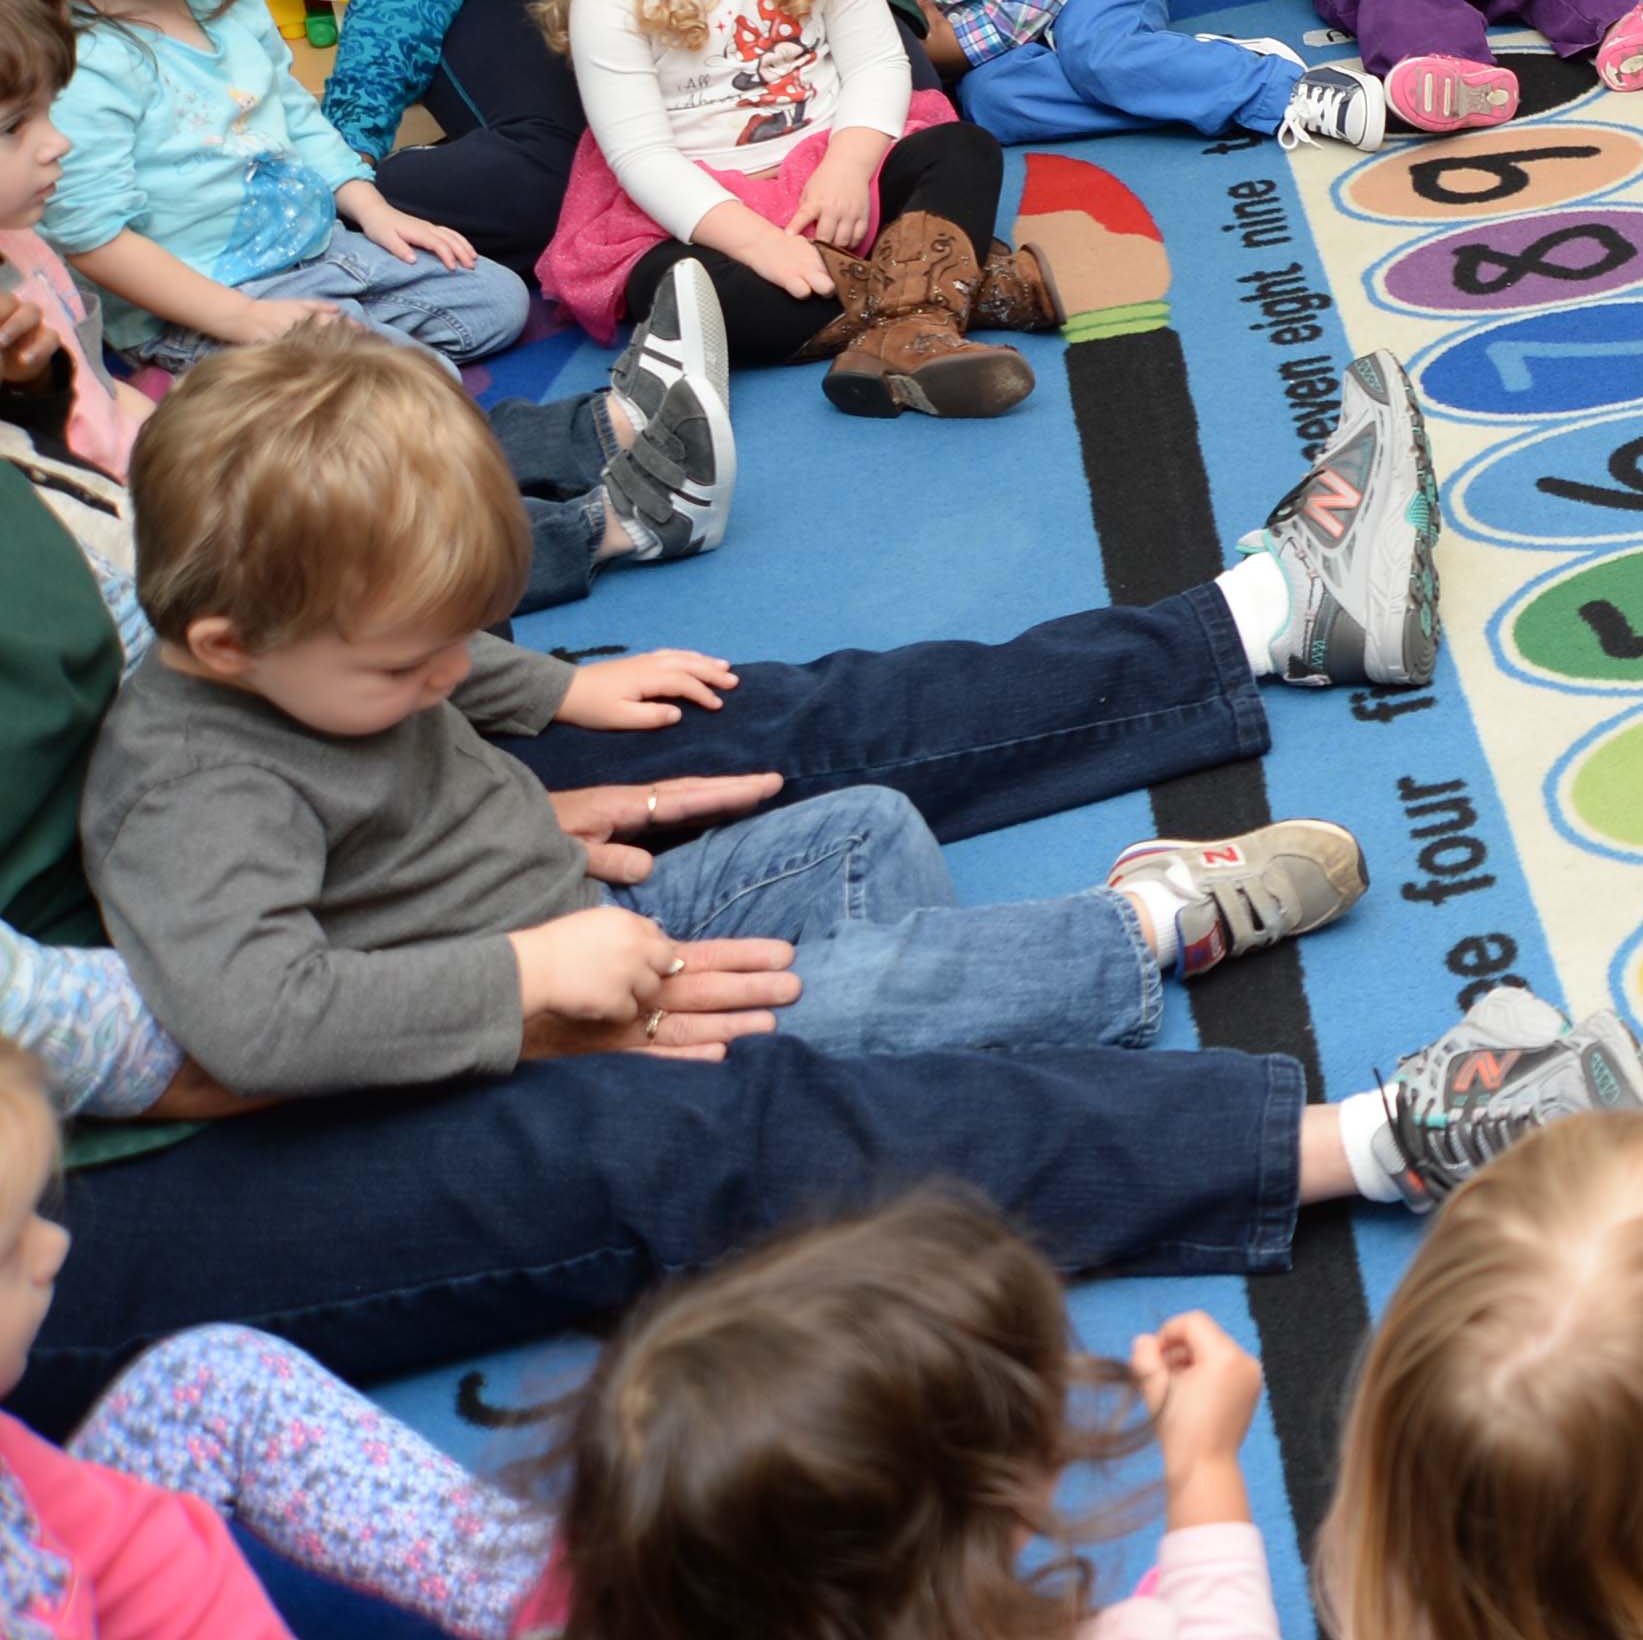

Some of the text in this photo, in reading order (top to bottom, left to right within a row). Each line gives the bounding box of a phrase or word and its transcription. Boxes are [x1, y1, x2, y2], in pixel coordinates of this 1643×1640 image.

[1409, 144, 1601, 205] 9
[1221, 179, 1293, 249] nine
[1450, 222, 1638, 295] 8
[1236, 262, 1333, 346] eight
[1305, 466, 1362, 537] N
[1396, 775, 1496, 907] four
